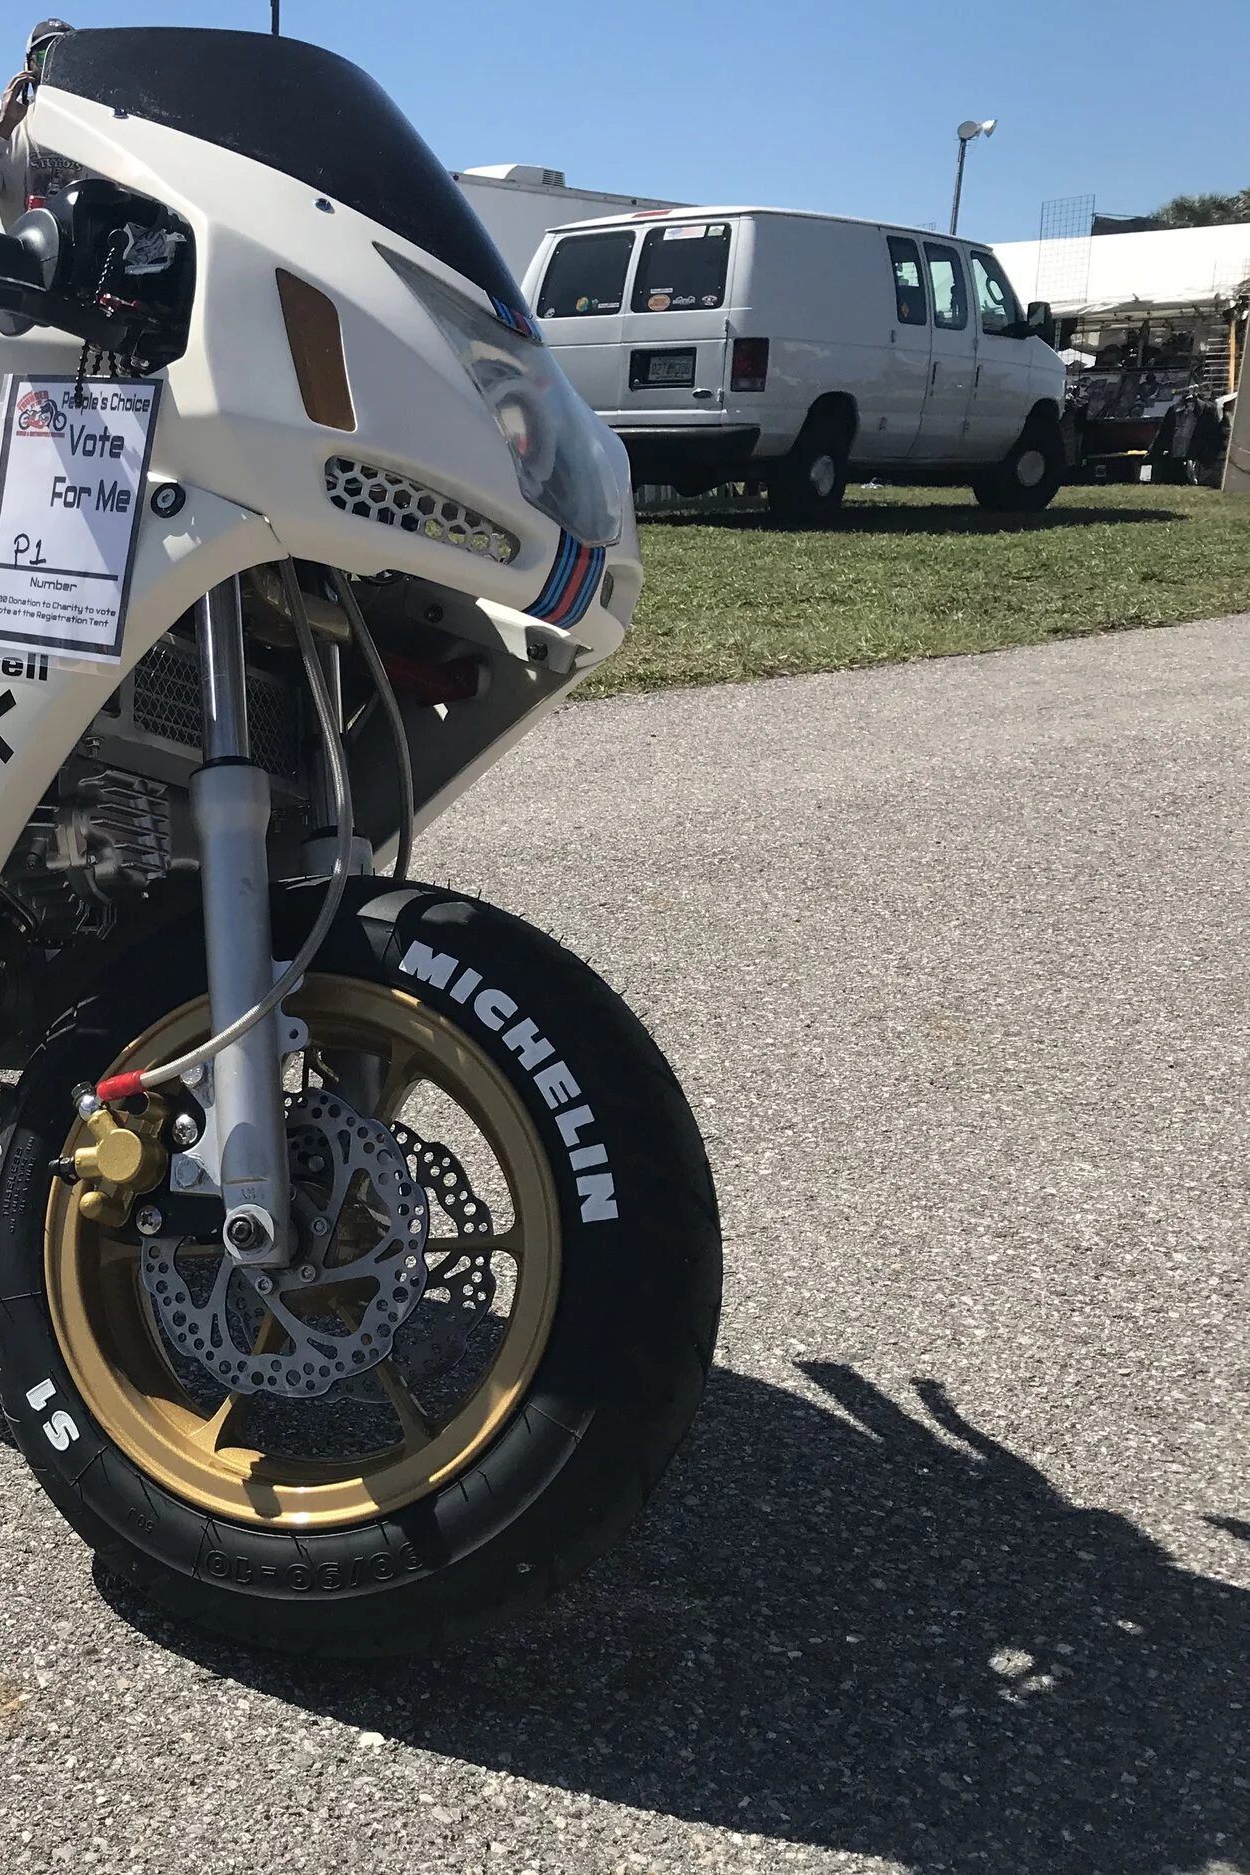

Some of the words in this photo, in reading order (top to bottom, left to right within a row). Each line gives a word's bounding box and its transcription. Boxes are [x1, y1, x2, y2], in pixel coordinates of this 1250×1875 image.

[61, 391, 107, 415] Peple's
[109, 393, 150, 412] Choice
[69, 424, 125, 459] Vote
[50, 475, 92, 509] For
[95, 479, 131, 513] Me
[29, 576, 78, 592] Number
[8, 596, 41, 607] Donation
[42, 600, 51, 608] to
[52, 601, 83, 615] Charity
[84, 605, 94, 614] to
[95, 608, 116, 617] vote
[12, 608, 22, 616] at
[23, 608, 35, 619] the
[36, 611, 88, 625] Registration
[89, 618, 109, 628] Tent
[399, 940, 619, 1223] MICHELIN
[26, 1378, 80, 1451] S1
